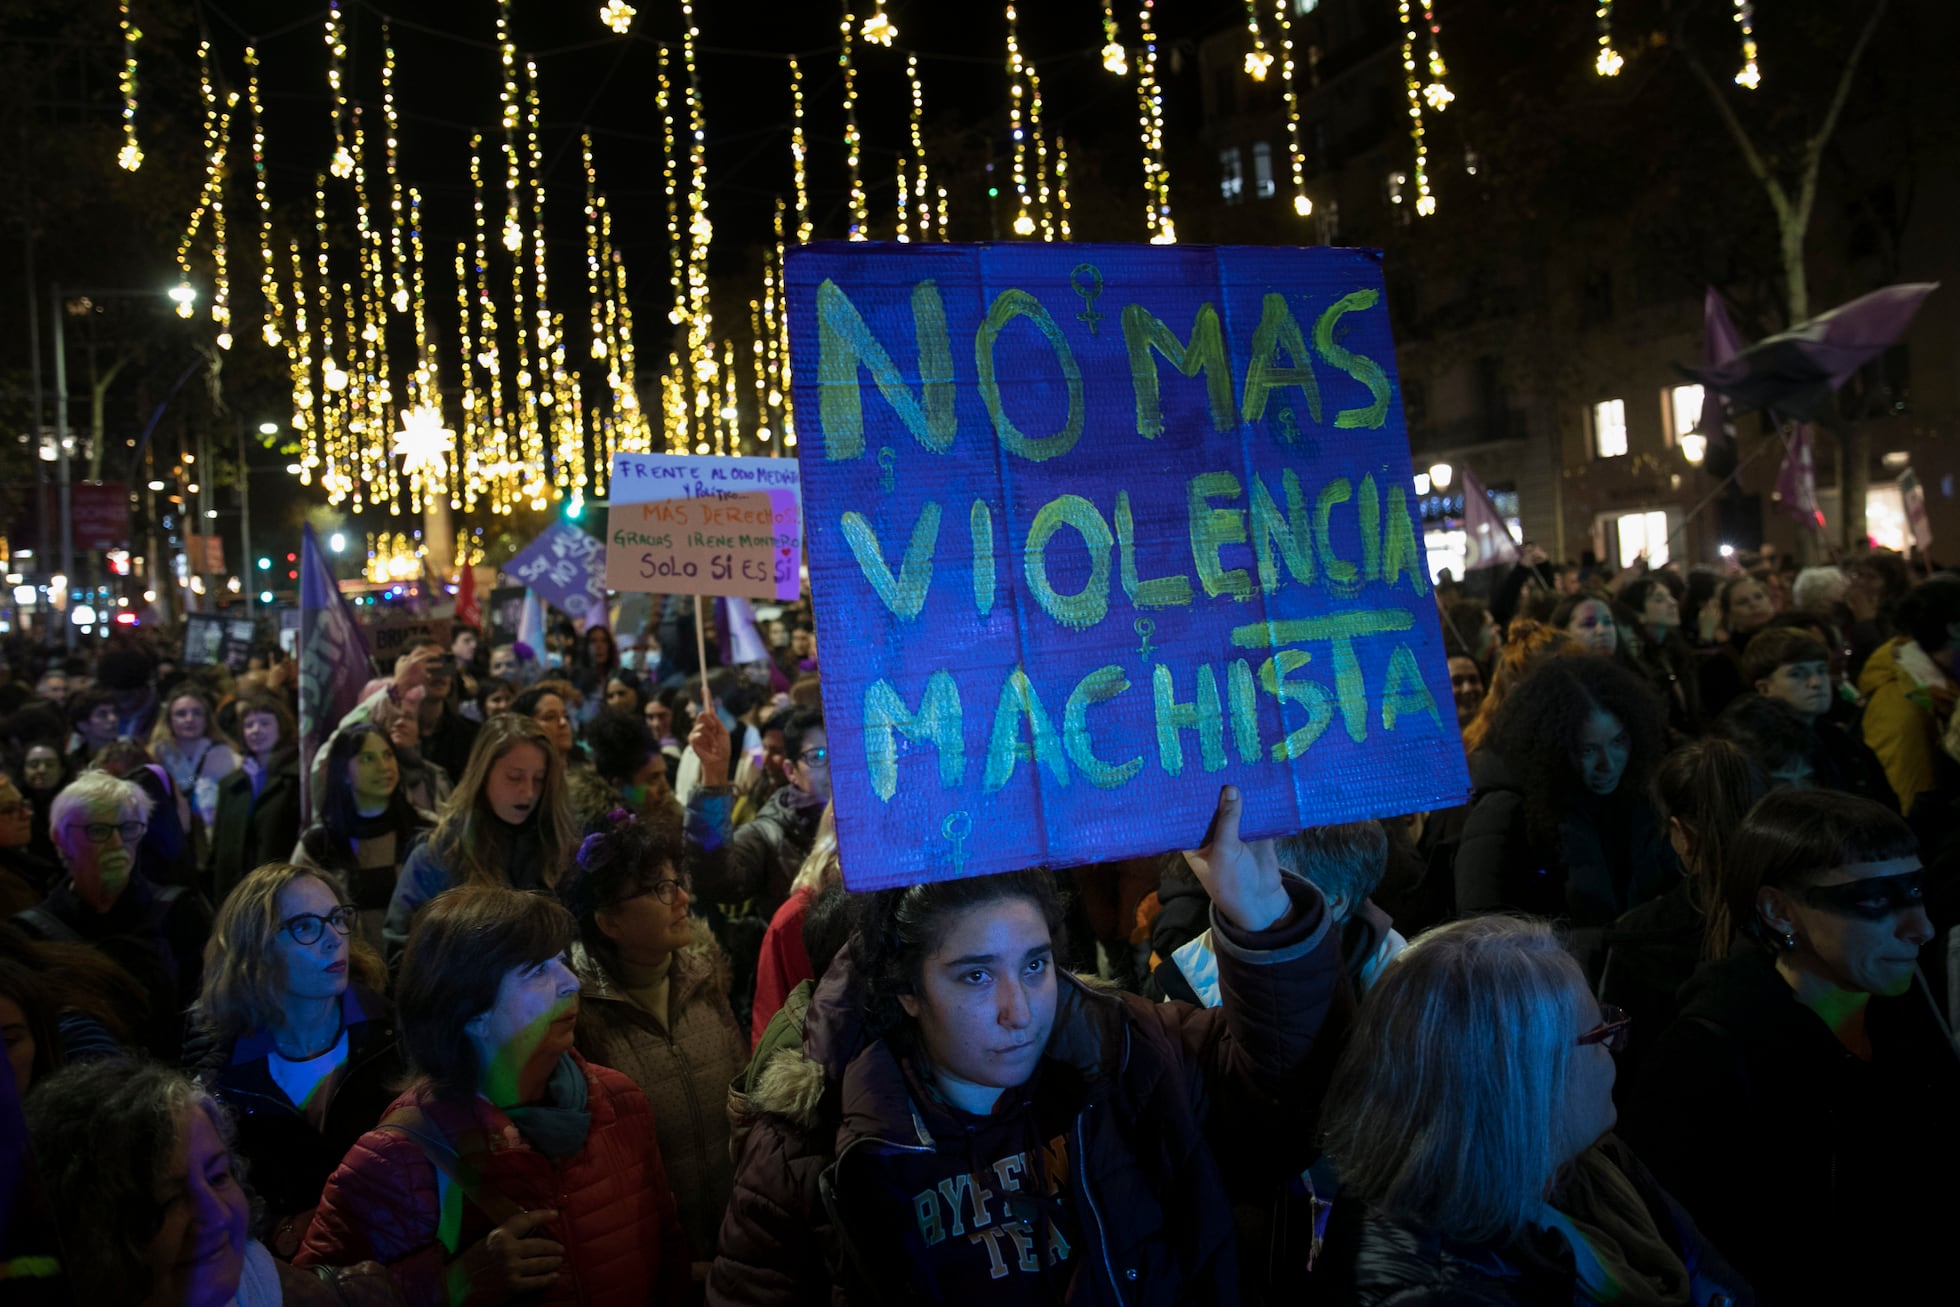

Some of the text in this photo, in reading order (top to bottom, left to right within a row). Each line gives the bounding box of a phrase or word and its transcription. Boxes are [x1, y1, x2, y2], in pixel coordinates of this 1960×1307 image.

[816, 278, 1392, 462] NO MAS
[619, 461, 699, 479] FRENTE
[711, 468, 727, 480] AL
[614, 529, 672, 548] GRACIAS
[688, 536, 734, 548] IRENE
[743, 559, 767, 581] ES
[840, 468, 1431, 631] VIOLENCIA
[862, 609, 1445, 802] MACHISTA
